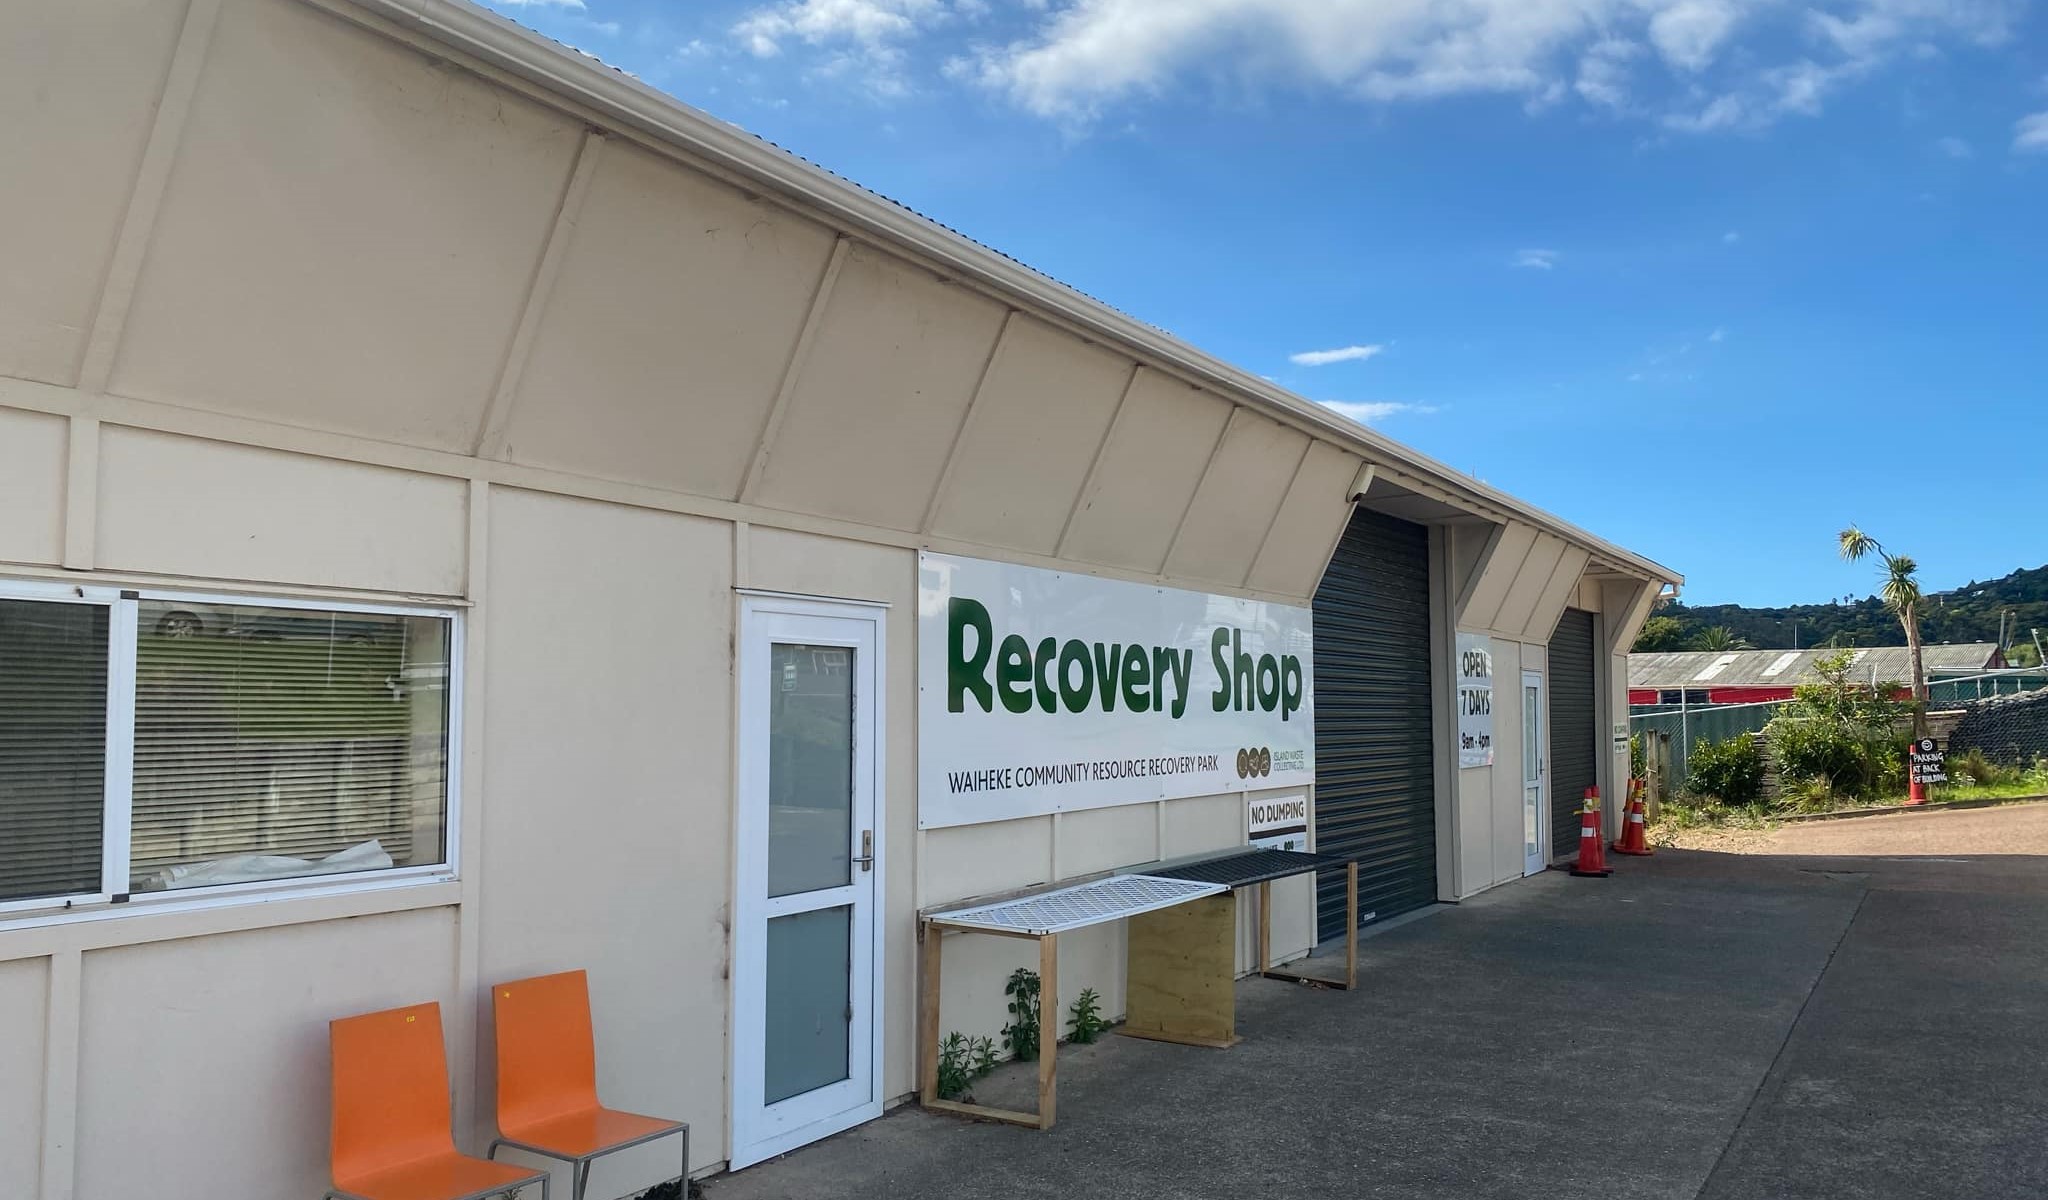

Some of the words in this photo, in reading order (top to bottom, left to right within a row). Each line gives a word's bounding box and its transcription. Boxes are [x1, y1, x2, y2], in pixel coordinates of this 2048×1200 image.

[948, 597, 1193, 719] Recovery
[1211, 627, 1302, 721] Shop
[1462, 651, 1487, 678] OPEN
[1461, 690, 1467, 716] 7
[1469, 690, 1490, 716] DAYS
[1462, 732, 1475, 750] 9am
[1478, 731, 1490, 750] 4pm
[1912, 765, 1921, 774] AT
[1922, 764, 1940, 773] BACK
[1913, 752, 1944, 763] PARKING
[948, 768, 1012, 794] WAIHEKE
[1015, 762, 1090, 787] COMMUNITY
[1093, 759, 1146, 781] RESOURCE
[1148, 756, 1196, 776] RECOVERY
[1198, 755, 1219, 772] PARK
[1922, 773, 1948, 783] BUILDING
[1251, 806, 1265, 825] NO
[1267, 801, 1304, 823] DUMPING
